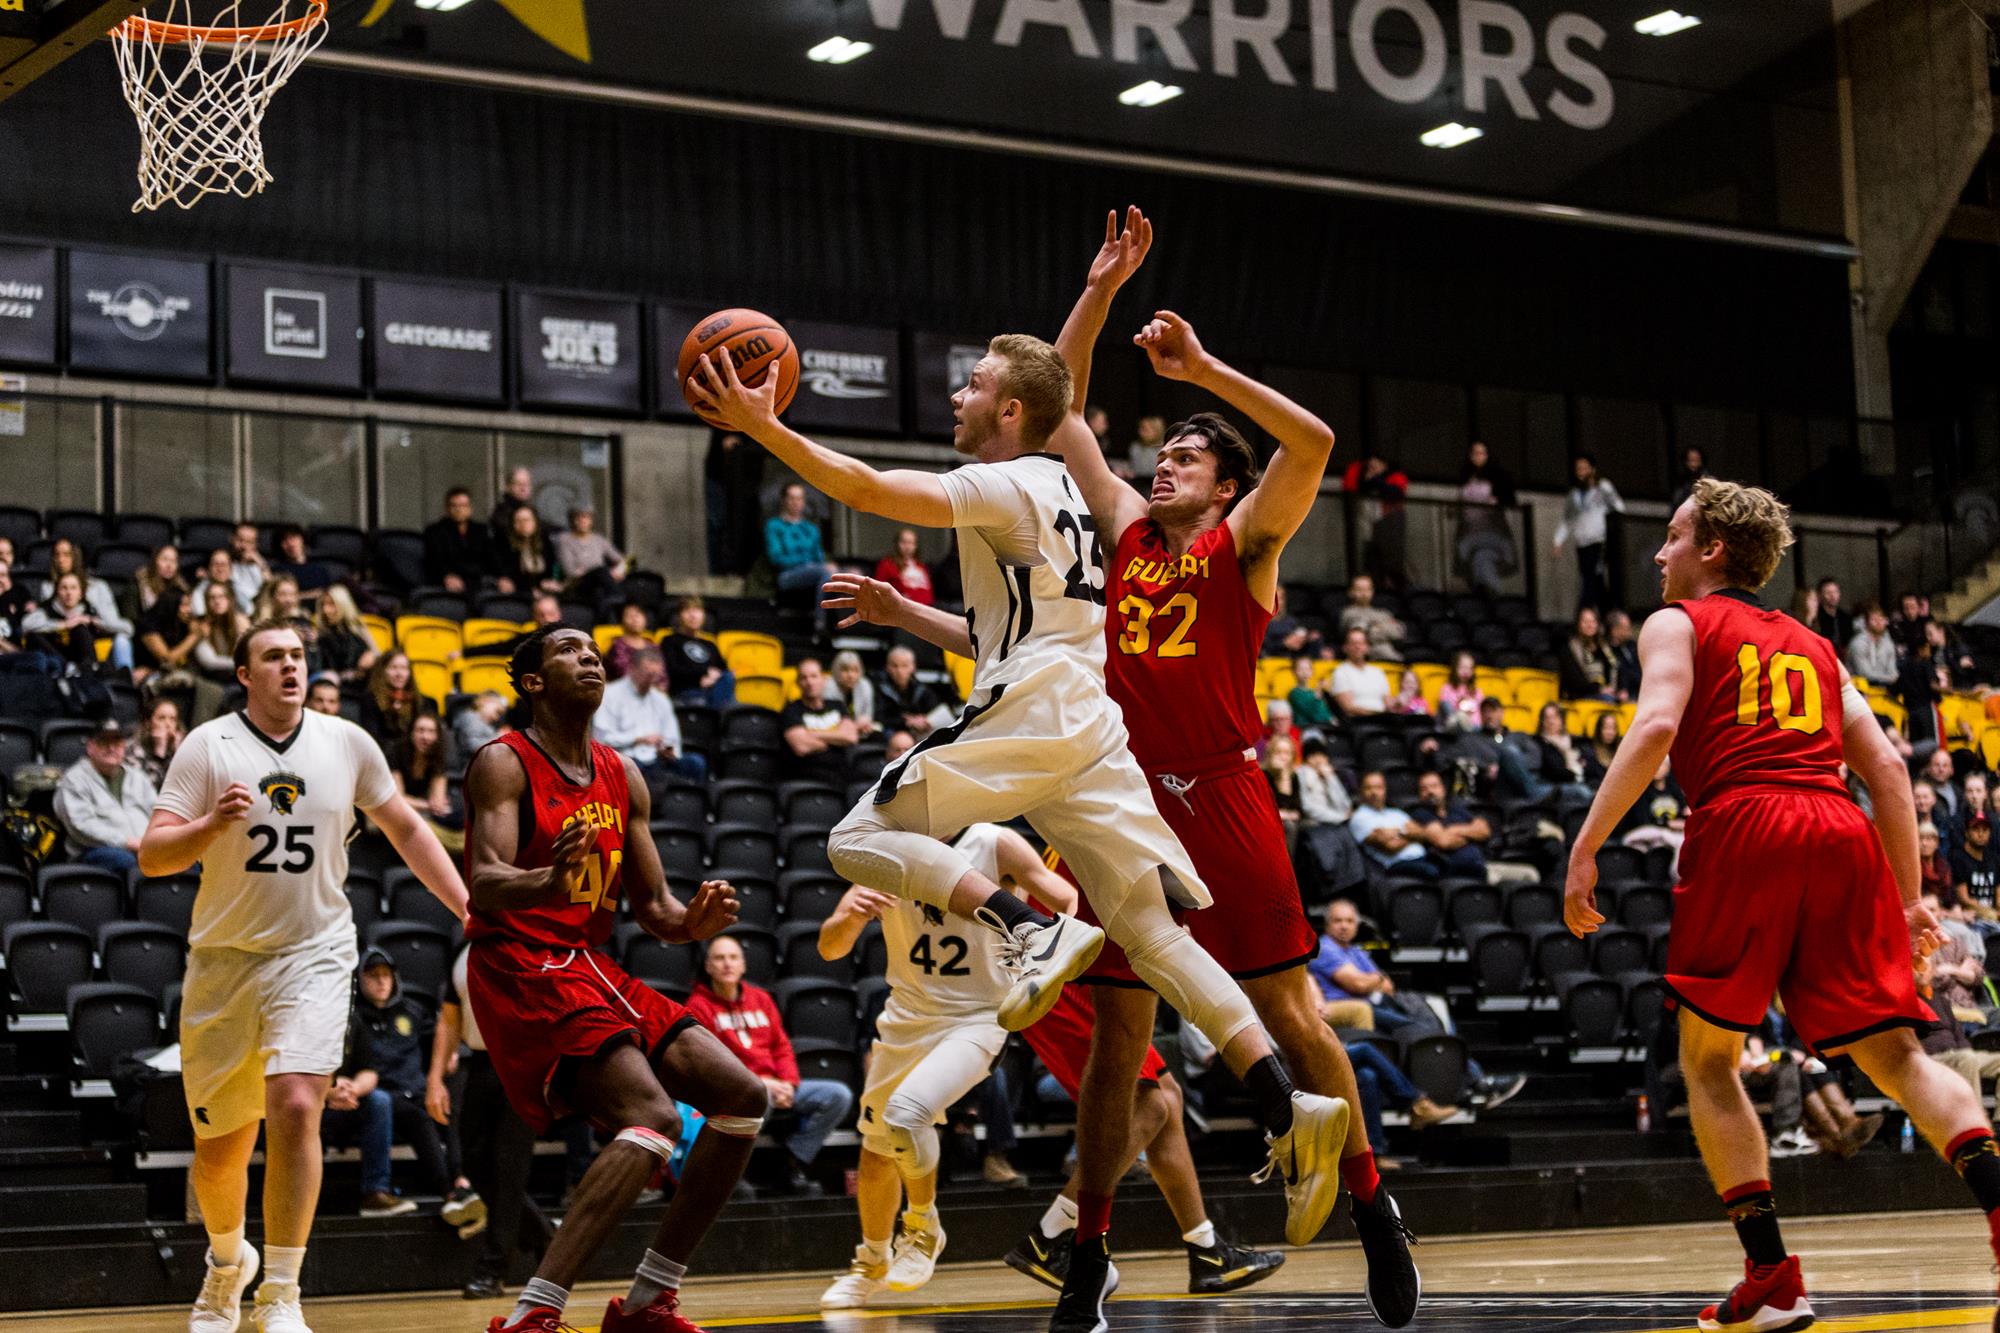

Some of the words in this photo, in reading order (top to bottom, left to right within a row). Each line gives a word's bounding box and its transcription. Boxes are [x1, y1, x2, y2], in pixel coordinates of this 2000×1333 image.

[385, 322, 492, 352] GATORADE
[1118, 592, 1199, 658] 32
[1736, 642, 1824, 736] 10
[244, 824, 315, 874] 25
[909, 933, 971, 976] 42
